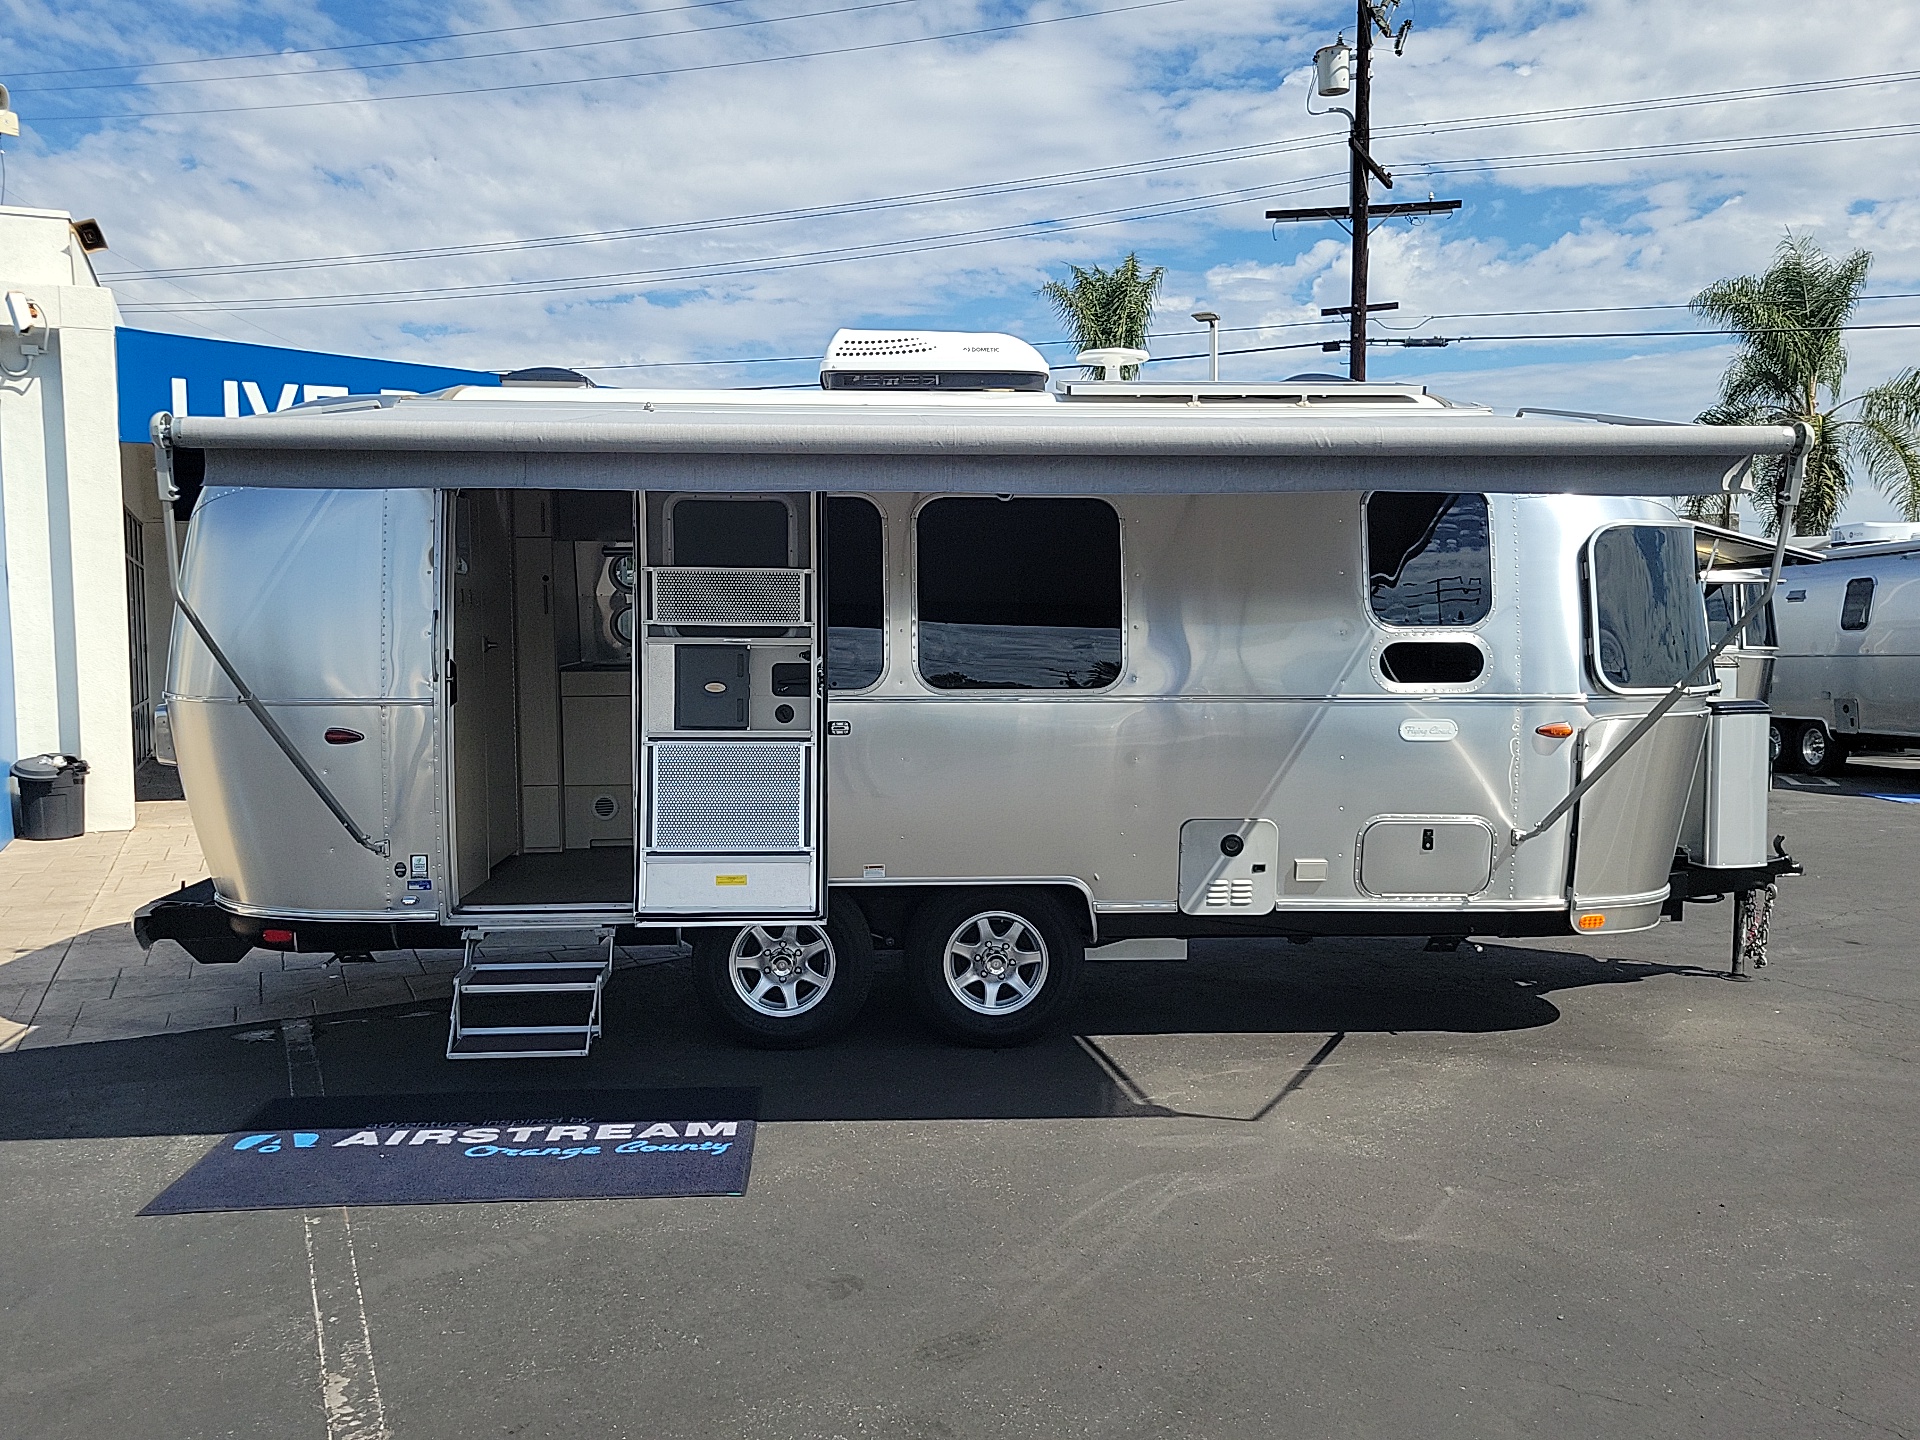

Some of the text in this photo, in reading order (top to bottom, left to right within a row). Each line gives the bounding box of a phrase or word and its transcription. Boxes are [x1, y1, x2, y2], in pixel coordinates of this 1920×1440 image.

[171, 377, 349, 418] LIV
[331, 1121, 738, 1148] AIRSTREAM
[464, 1139, 734, 1161] Orange County
